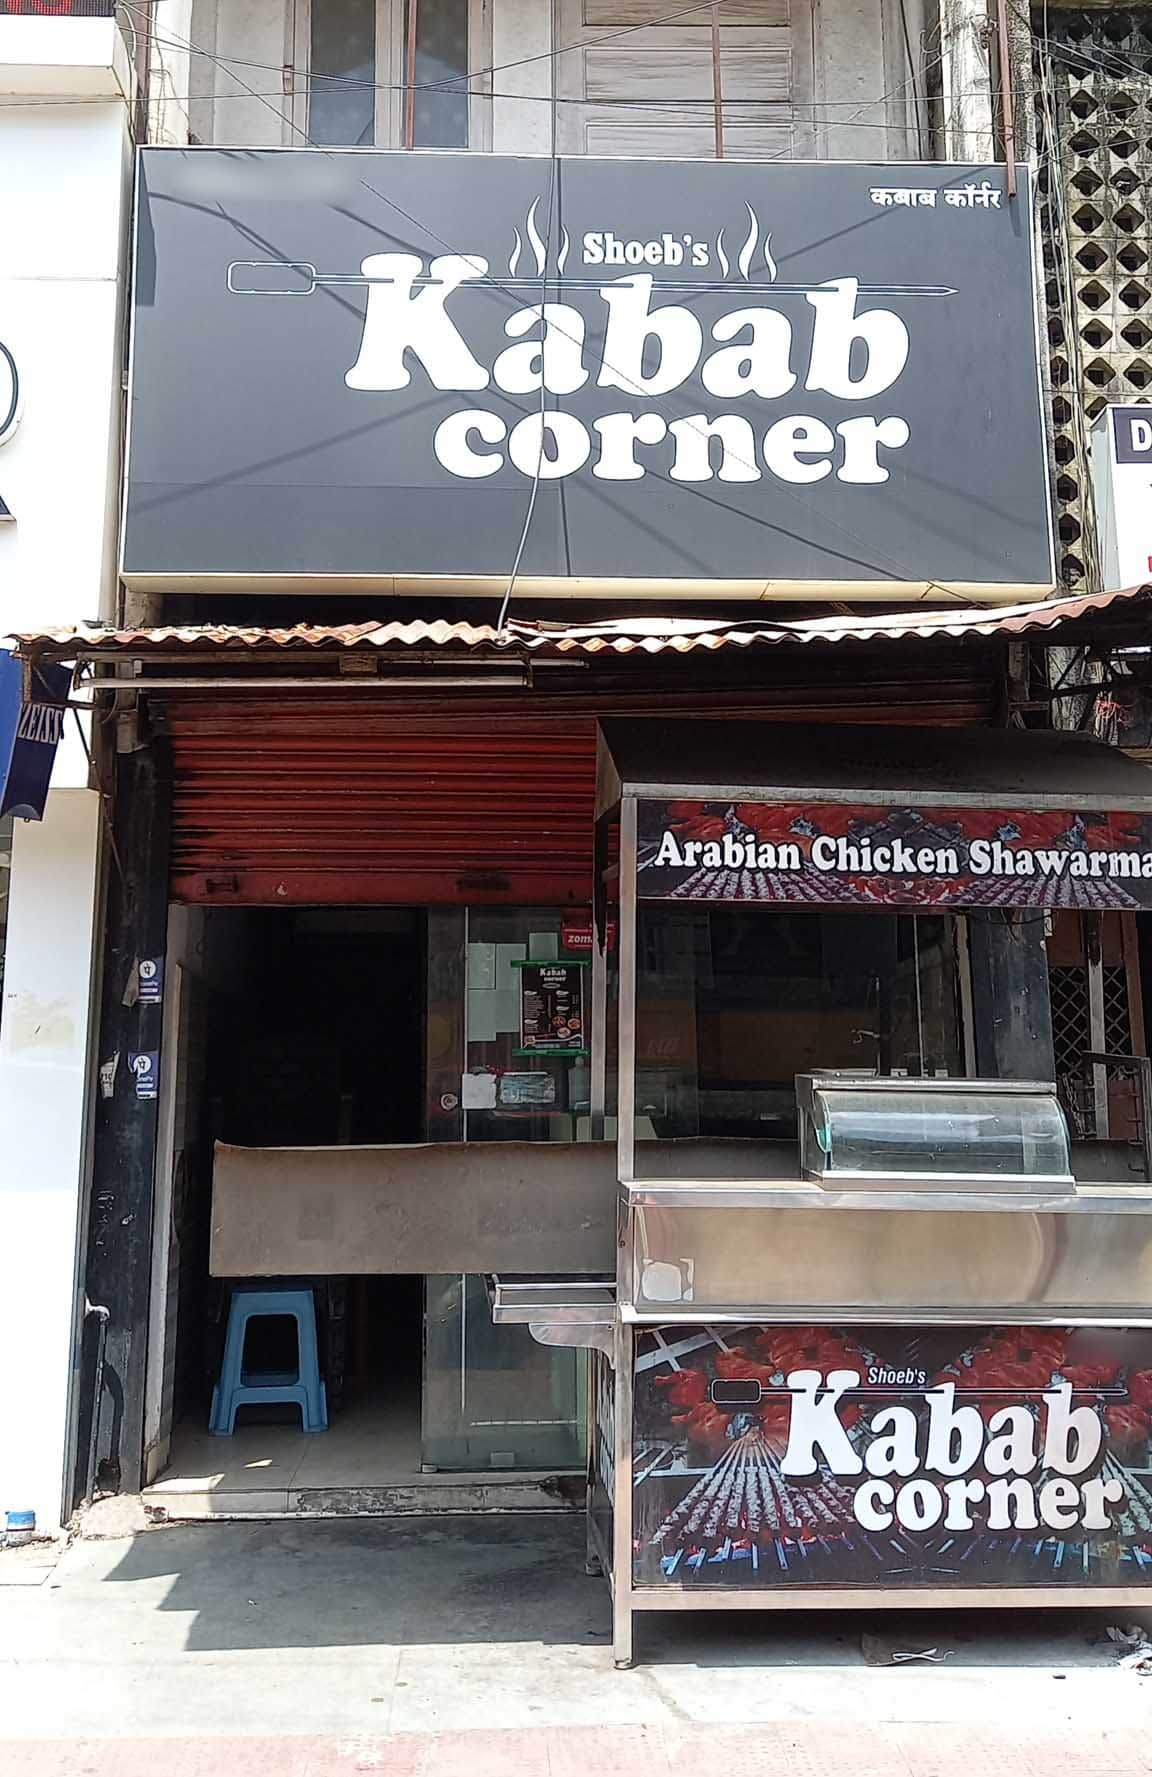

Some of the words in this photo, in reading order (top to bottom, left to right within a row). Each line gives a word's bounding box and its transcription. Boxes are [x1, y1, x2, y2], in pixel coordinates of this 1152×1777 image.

[869, 188, 937, 207] कबाब
[943, 182, 1001, 208] कॉर्नर
[582, 232, 710, 266] Shoeb's
[344, 252, 910, 400] Kabab
[433, 408, 910, 484] corner
[18, 703, 63, 744] ZEISS
[654, 831, 800, 870] Arabian
[812, 836, 959, 873] Chicken
[969, 839, 1152, 877] Shawarma
[868, 1367, 926, 1385] Shoeb's
[781, 1369, 1102, 1476] Kabab
[853, 1478, 1123, 1531] corner
